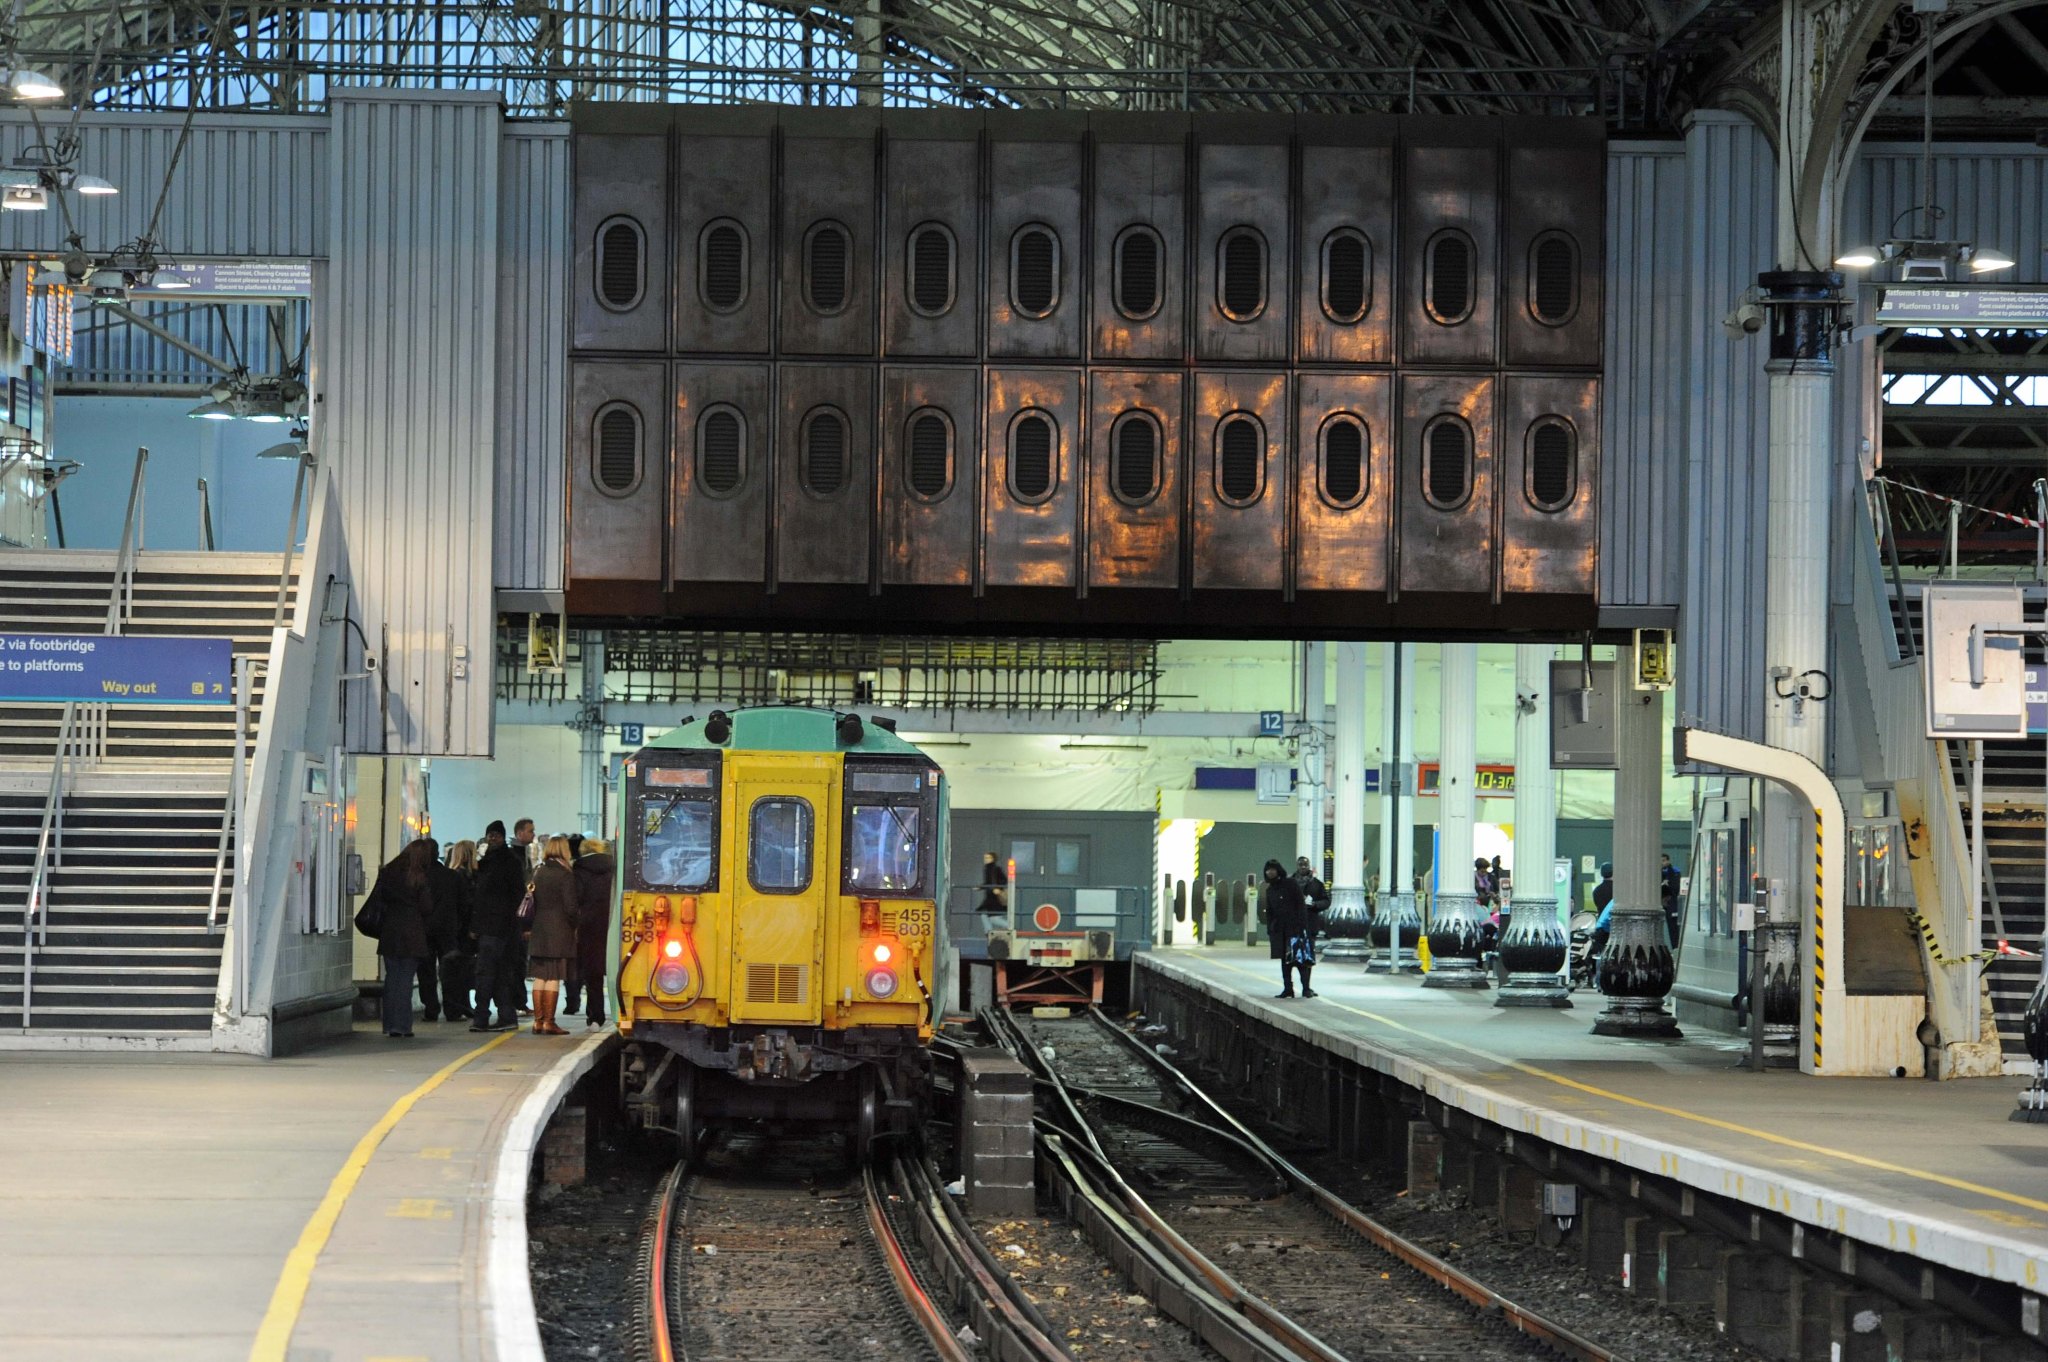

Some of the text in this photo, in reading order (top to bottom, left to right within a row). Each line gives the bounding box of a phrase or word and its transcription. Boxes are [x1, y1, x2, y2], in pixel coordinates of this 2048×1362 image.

[1898, 302, 1931, 310] Platforms
[8, 638, 26, 650] via
[29, 638, 95, 654] footbridge
[7, 659, 21, 671] to
[24, 659, 84, 673] platforms
[102, 680, 157, 696] Way out
[1263, 713, 1281, 729] 12
[623, 725, 640, 742] 13
[622, 913, 654, 930] 45
[899, 908, 931, 922] 455
[622, 930, 654, 943] 803
[899, 922, 931, 936] 803
